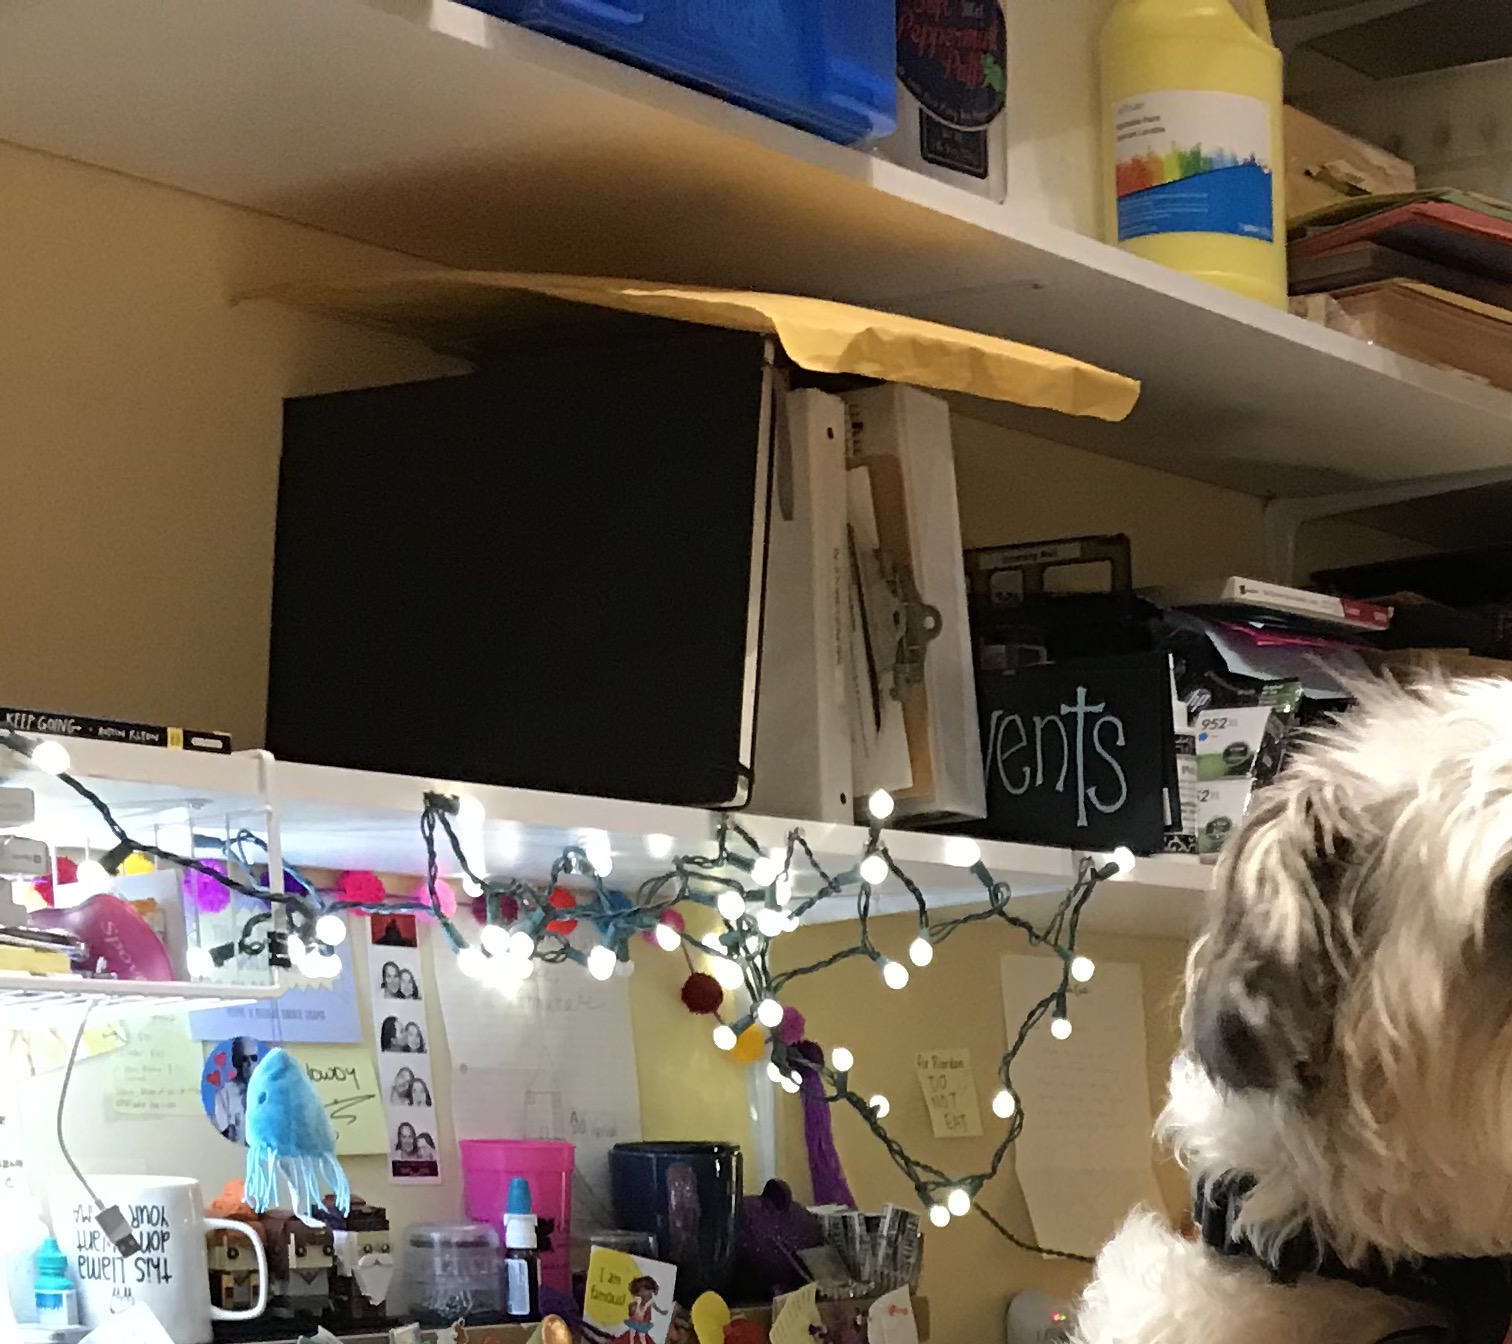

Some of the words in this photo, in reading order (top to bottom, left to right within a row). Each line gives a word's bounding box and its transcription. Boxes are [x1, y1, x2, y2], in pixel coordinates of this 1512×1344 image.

[1185, 688, 1212, 713] hp
[6, 712, 36, 730] KEEP
[37, 715, 76, 734] GOING
[1201, 716, 1228, 731] 952
[927, 1073, 947, 1092] DO
